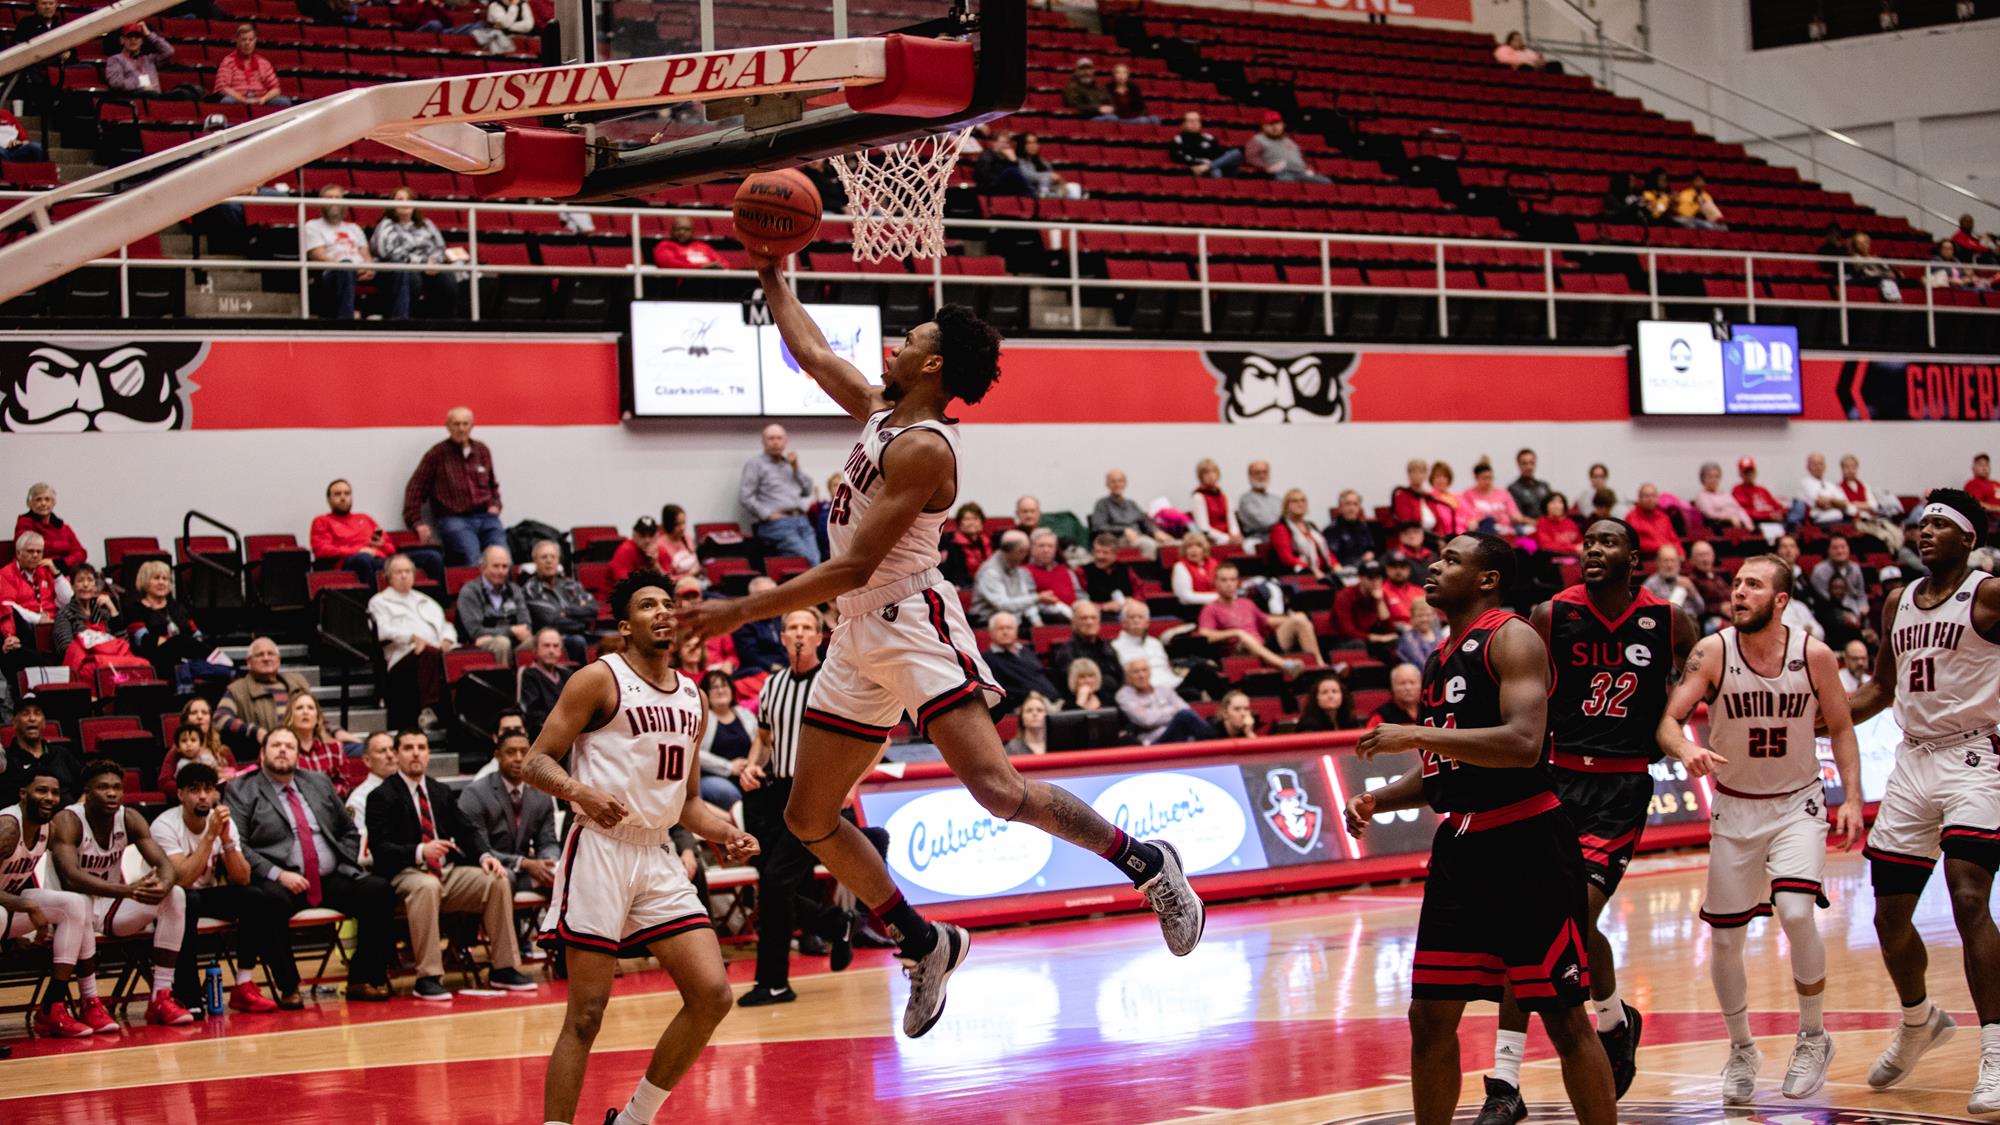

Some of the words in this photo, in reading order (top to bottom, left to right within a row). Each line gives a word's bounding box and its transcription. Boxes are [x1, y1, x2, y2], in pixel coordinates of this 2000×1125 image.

[413, 62, 632, 119] AUSTIN
[654, 46, 817, 96] PEAY
[749, 303, 771, 325] M
[1906, 363, 2000, 420] GOVER
[829, 482, 852, 526] 23
[1571, 641, 1652, 667] SIUe
[1893, 622, 1932, 657] AUSTIN
[1932, 621, 1966, 651] PEAY
[1421, 675, 1467, 707] Ue
[1909, 656, 1936, 693] 21
[1582, 671, 1638, 718] 32
[1723, 690, 1774, 719] AUSTIN
[1778, 692, 1812, 719] PEAY
[624, 706, 676, 737] AUSTIN
[679, 708, 699, 743] PEA
[1748, 726, 1788, 758] 25
[656, 743, 685, 781] 10
[1682, 790, 1699, 812] 2
[908, 817, 1009, 873] Culvers
